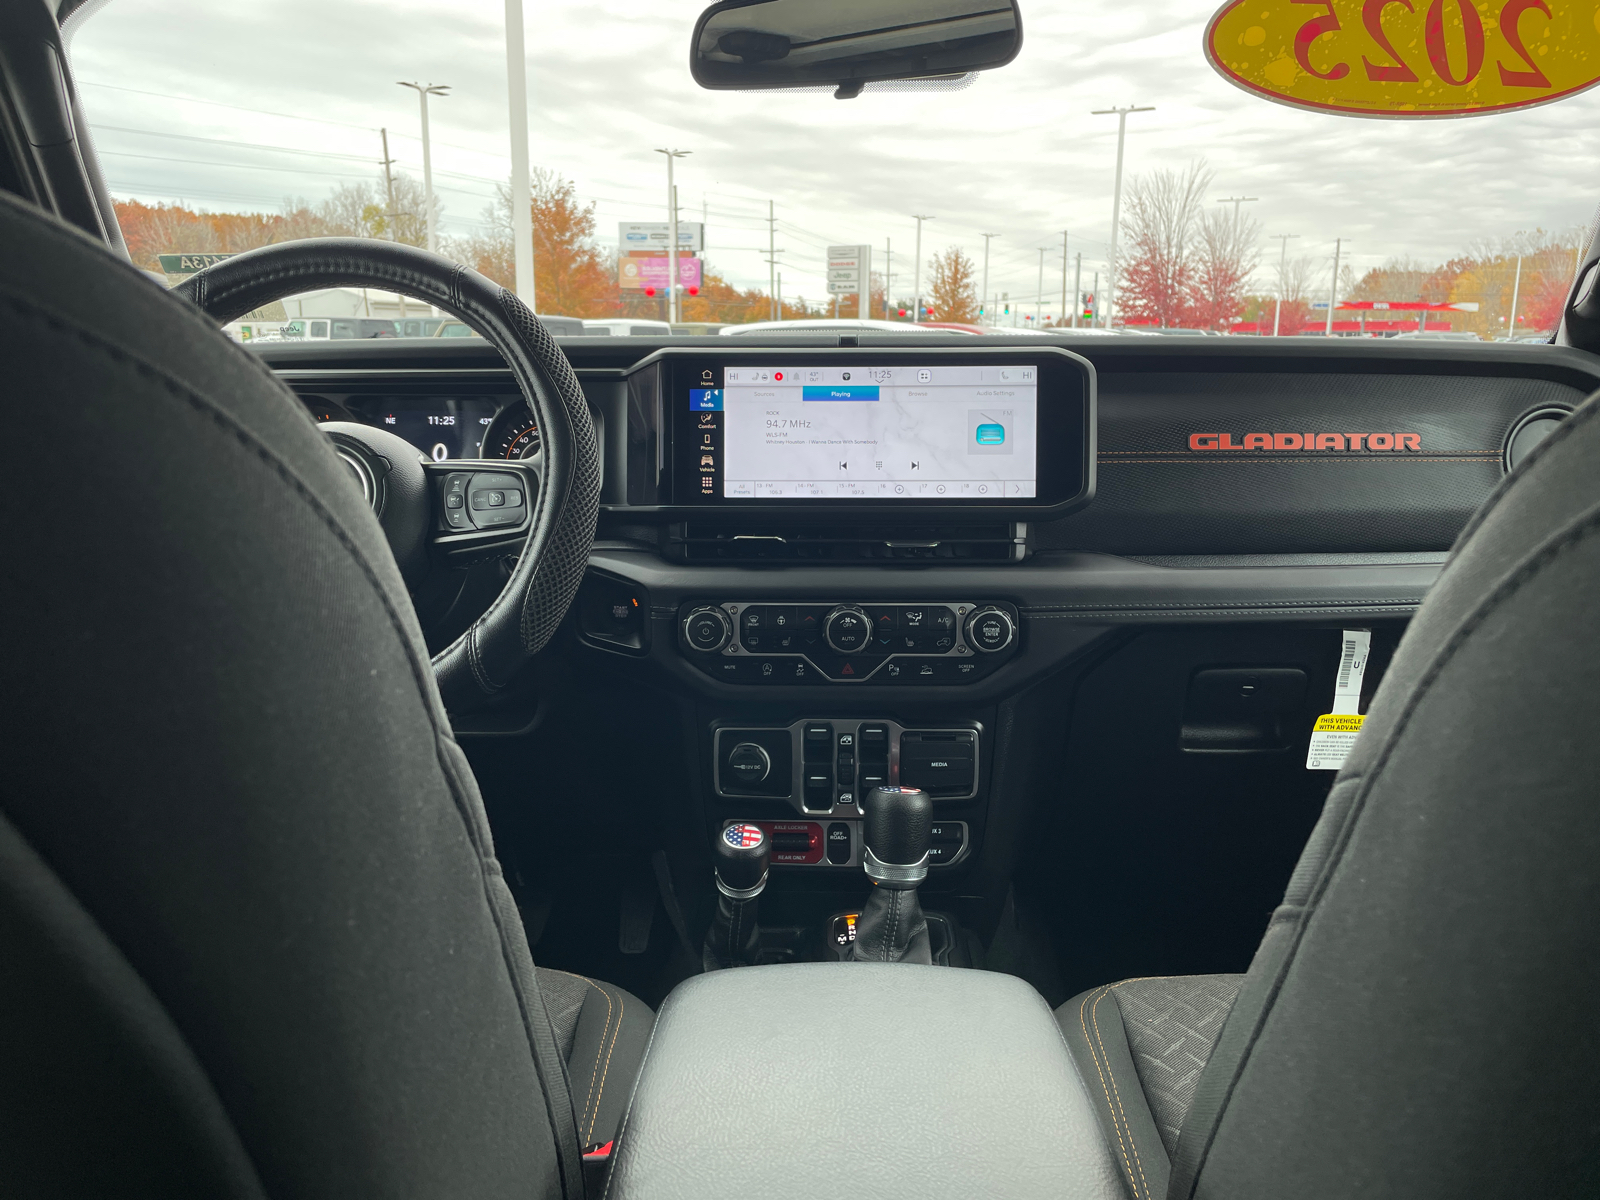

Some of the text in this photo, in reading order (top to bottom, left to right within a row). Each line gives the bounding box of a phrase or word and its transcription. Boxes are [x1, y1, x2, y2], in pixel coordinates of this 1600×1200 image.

[869, 370, 892, 378] 11:25
[1022, 371, 1032, 379] HI
[993, 390, 1015, 398] Settings
[385, 416, 396, 425] NE
[427, 416, 455, 424] 11:25
[766, 420, 811, 428] 94.7 MHz
[1188, 431, 1422, 453] GLADIATOR
[432, 443, 448, 462] 0
